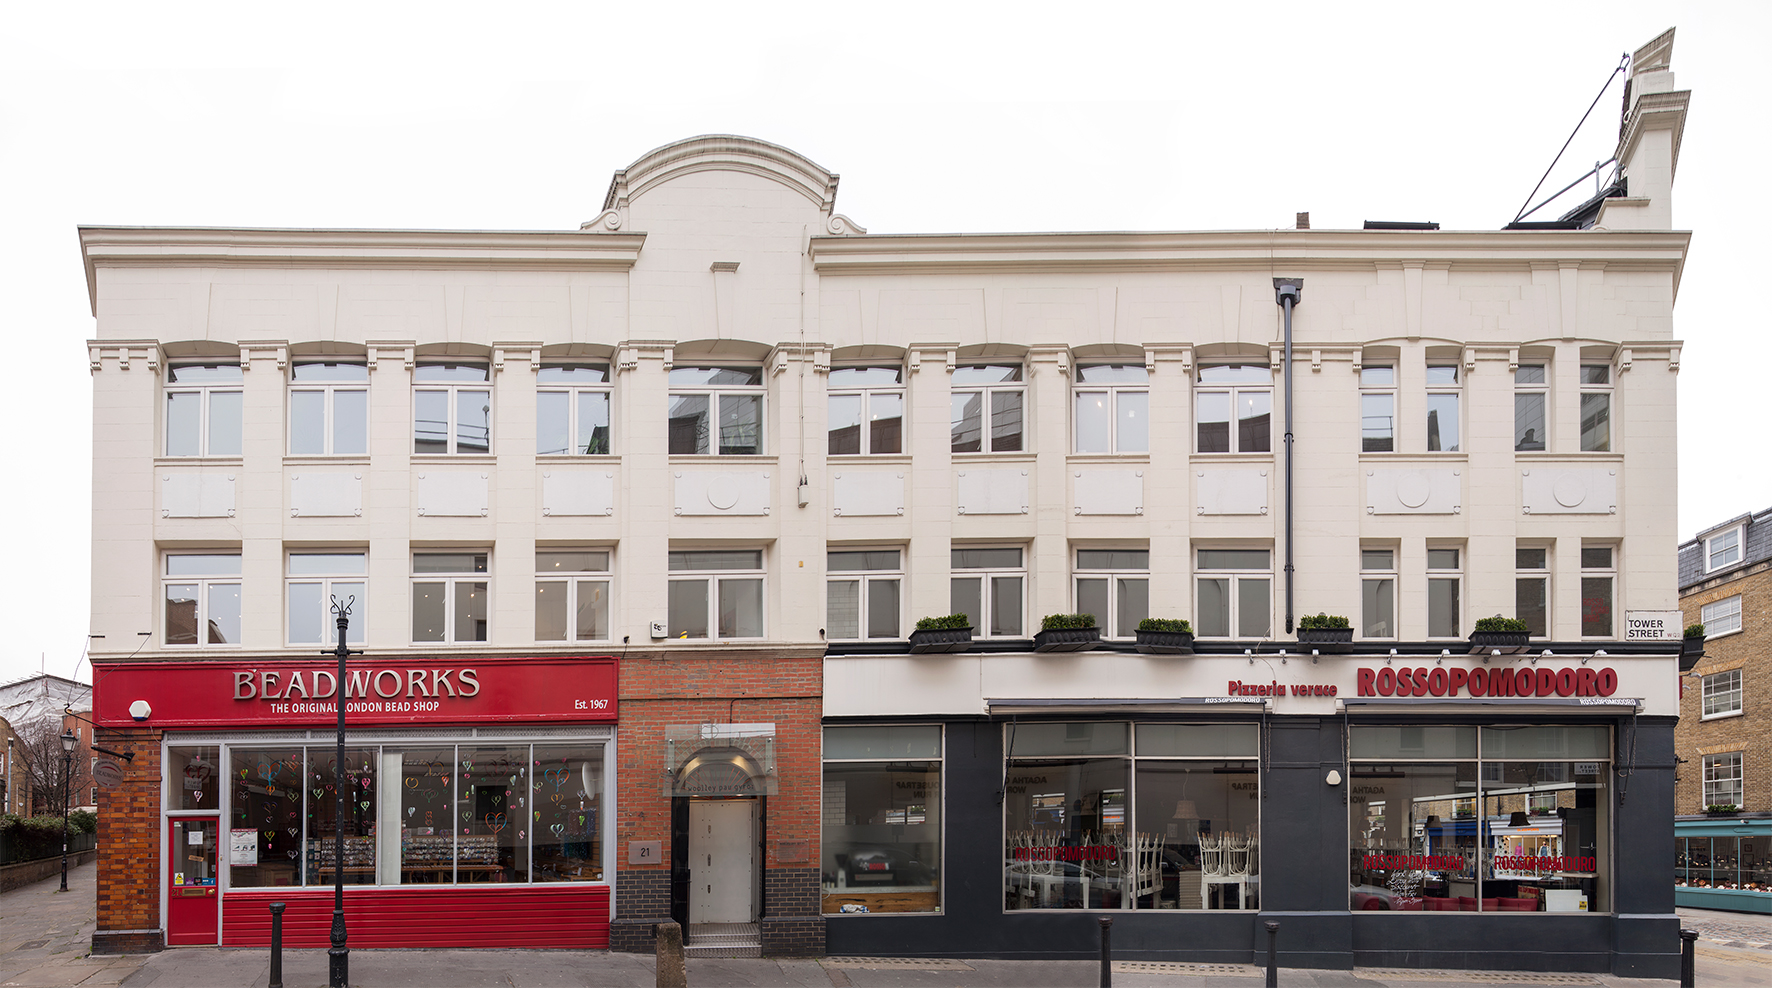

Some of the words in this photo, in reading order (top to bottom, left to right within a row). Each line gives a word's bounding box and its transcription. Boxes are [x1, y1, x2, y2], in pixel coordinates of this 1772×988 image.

[1583, 598, 1604, 606] ROSSO
[1591, 606, 1610, 614] POMO
[1583, 614, 1600, 622] DORO
[1628, 620, 1663, 628] TOWER
[1628, 630, 1664, 638] STREET
[232, 668, 480, 700] BEADWORKS
[1357, 666, 1618, 698] ROSSOPOMODORO
[1228, 680, 1287, 697] Pizzeria
[1290, 684, 1338, 697] verace
[271, 703, 289, 713] THE
[291, 702, 339, 713] ORIGINAL
[345, 702, 382, 712] ONDON
[385, 701, 411, 712] BEAD
[413, 701, 440, 711] SHOP
[574, 699, 588, 709] Est.
[590, 699, 609, 709] 1967
[1579, 698, 1637, 706] ROSSOPOMODORO
[687, 784, 716, 793] woolley
[719, 784, 731, 792] pau
[641, 847, 650, 857] 21
[1015, 845, 1116, 862] ROSSOPOMODORO
[1363, 854, 1464, 870] ROSSOPOMODORO
[1494, 855, 1596, 871] ROSSOPOMODORO
